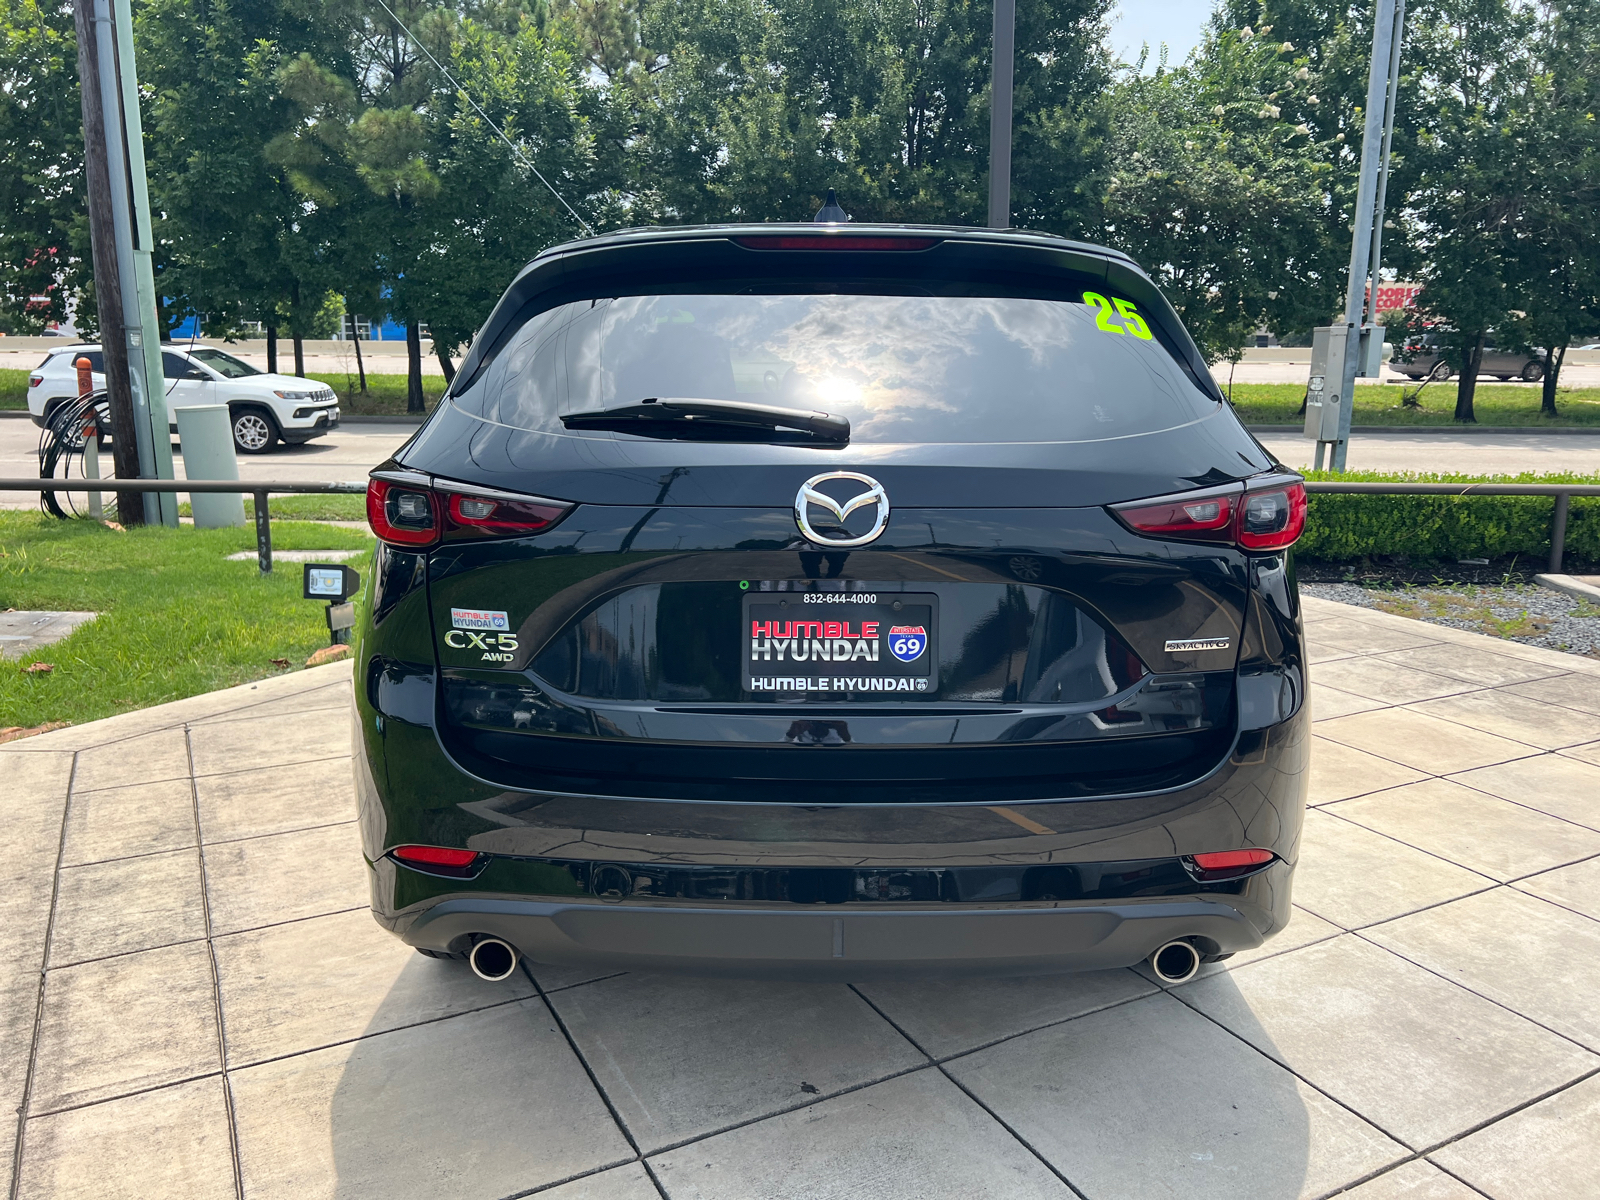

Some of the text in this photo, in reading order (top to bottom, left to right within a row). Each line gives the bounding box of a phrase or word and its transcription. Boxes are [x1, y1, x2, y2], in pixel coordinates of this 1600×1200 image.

[1366, 288, 1405, 298] OOR
[1366, 298, 1404, 308] COR
[1083, 291, 1153, 340] 25
[803, 594, 877, 604] 832-644-4000
[453, 611, 490, 620] HUMBLE
[454, 618, 492, 628] HYUNDAI
[494, 618, 504, 626] 69
[752, 621, 879, 638] HUMBLE
[444, 630, 519, 651] CX-5
[752, 639, 879, 661] HYUNDAI
[894, 638, 920, 655] 69
[481, 652, 514, 662] AWD
[751, 677, 914, 691] HUMBLE HYUNDAI
